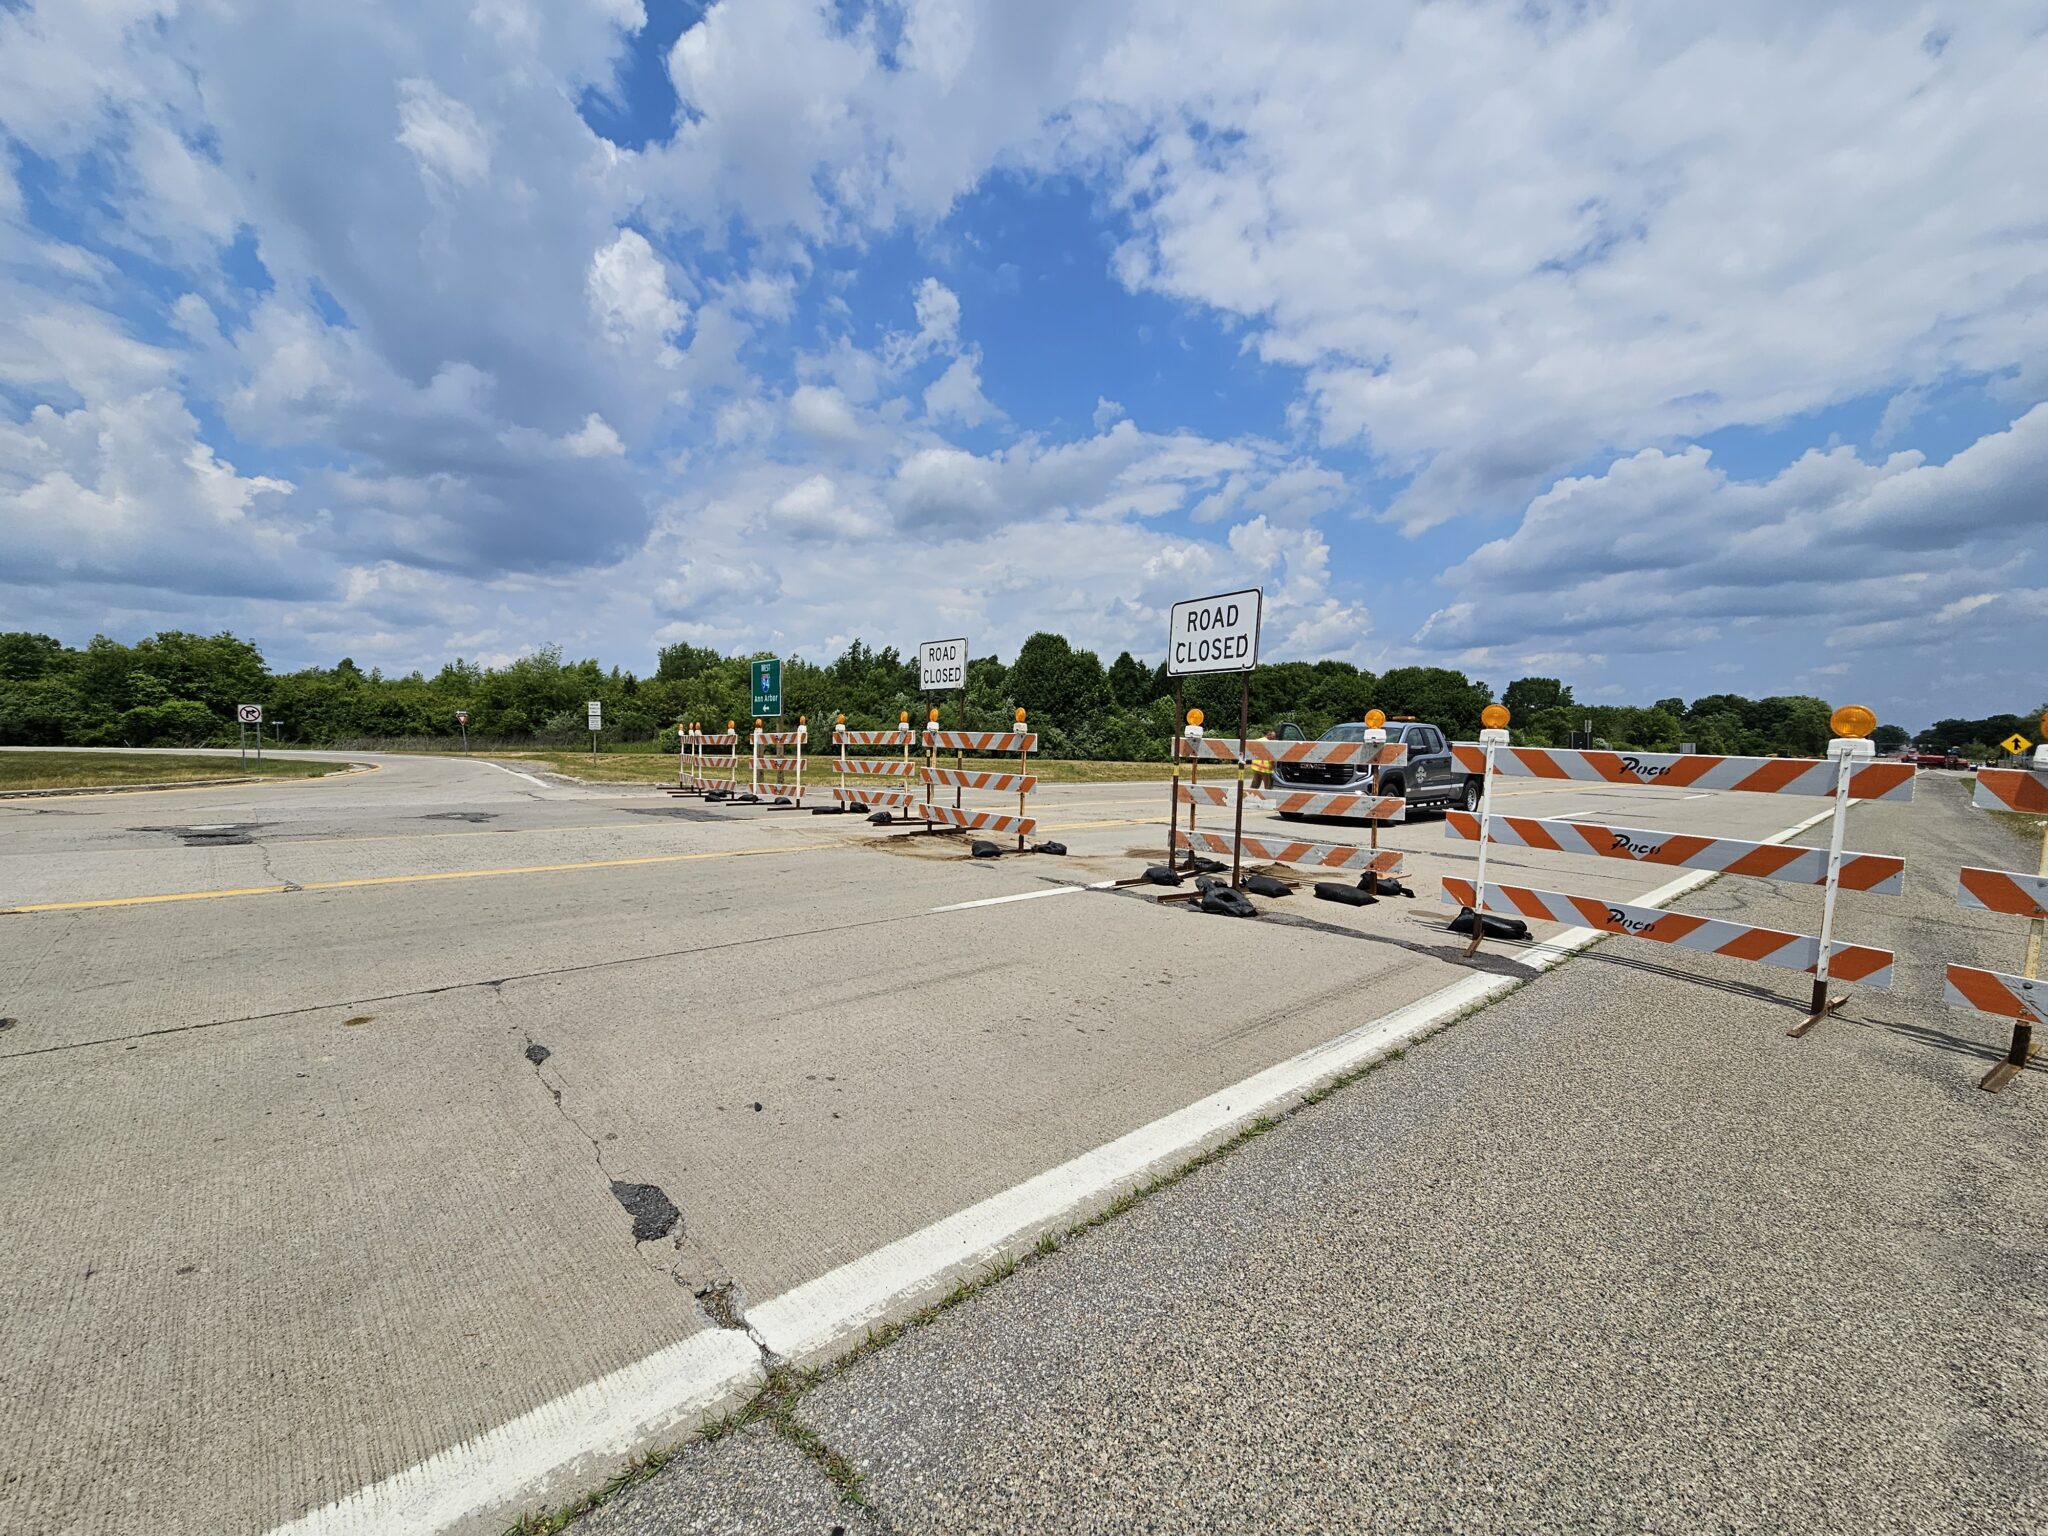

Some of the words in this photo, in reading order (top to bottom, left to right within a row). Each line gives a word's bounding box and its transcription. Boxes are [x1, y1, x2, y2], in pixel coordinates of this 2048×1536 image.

[1187, 604, 1239, 633] ROAD
[929, 645, 956, 662] ROAD
[1175, 635, 1249, 664] CLOSED
[923, 667, 961, 684] CLOSED
[754, 695, 764, 703] Ann
[764, 694, 778, 702] Arbor
